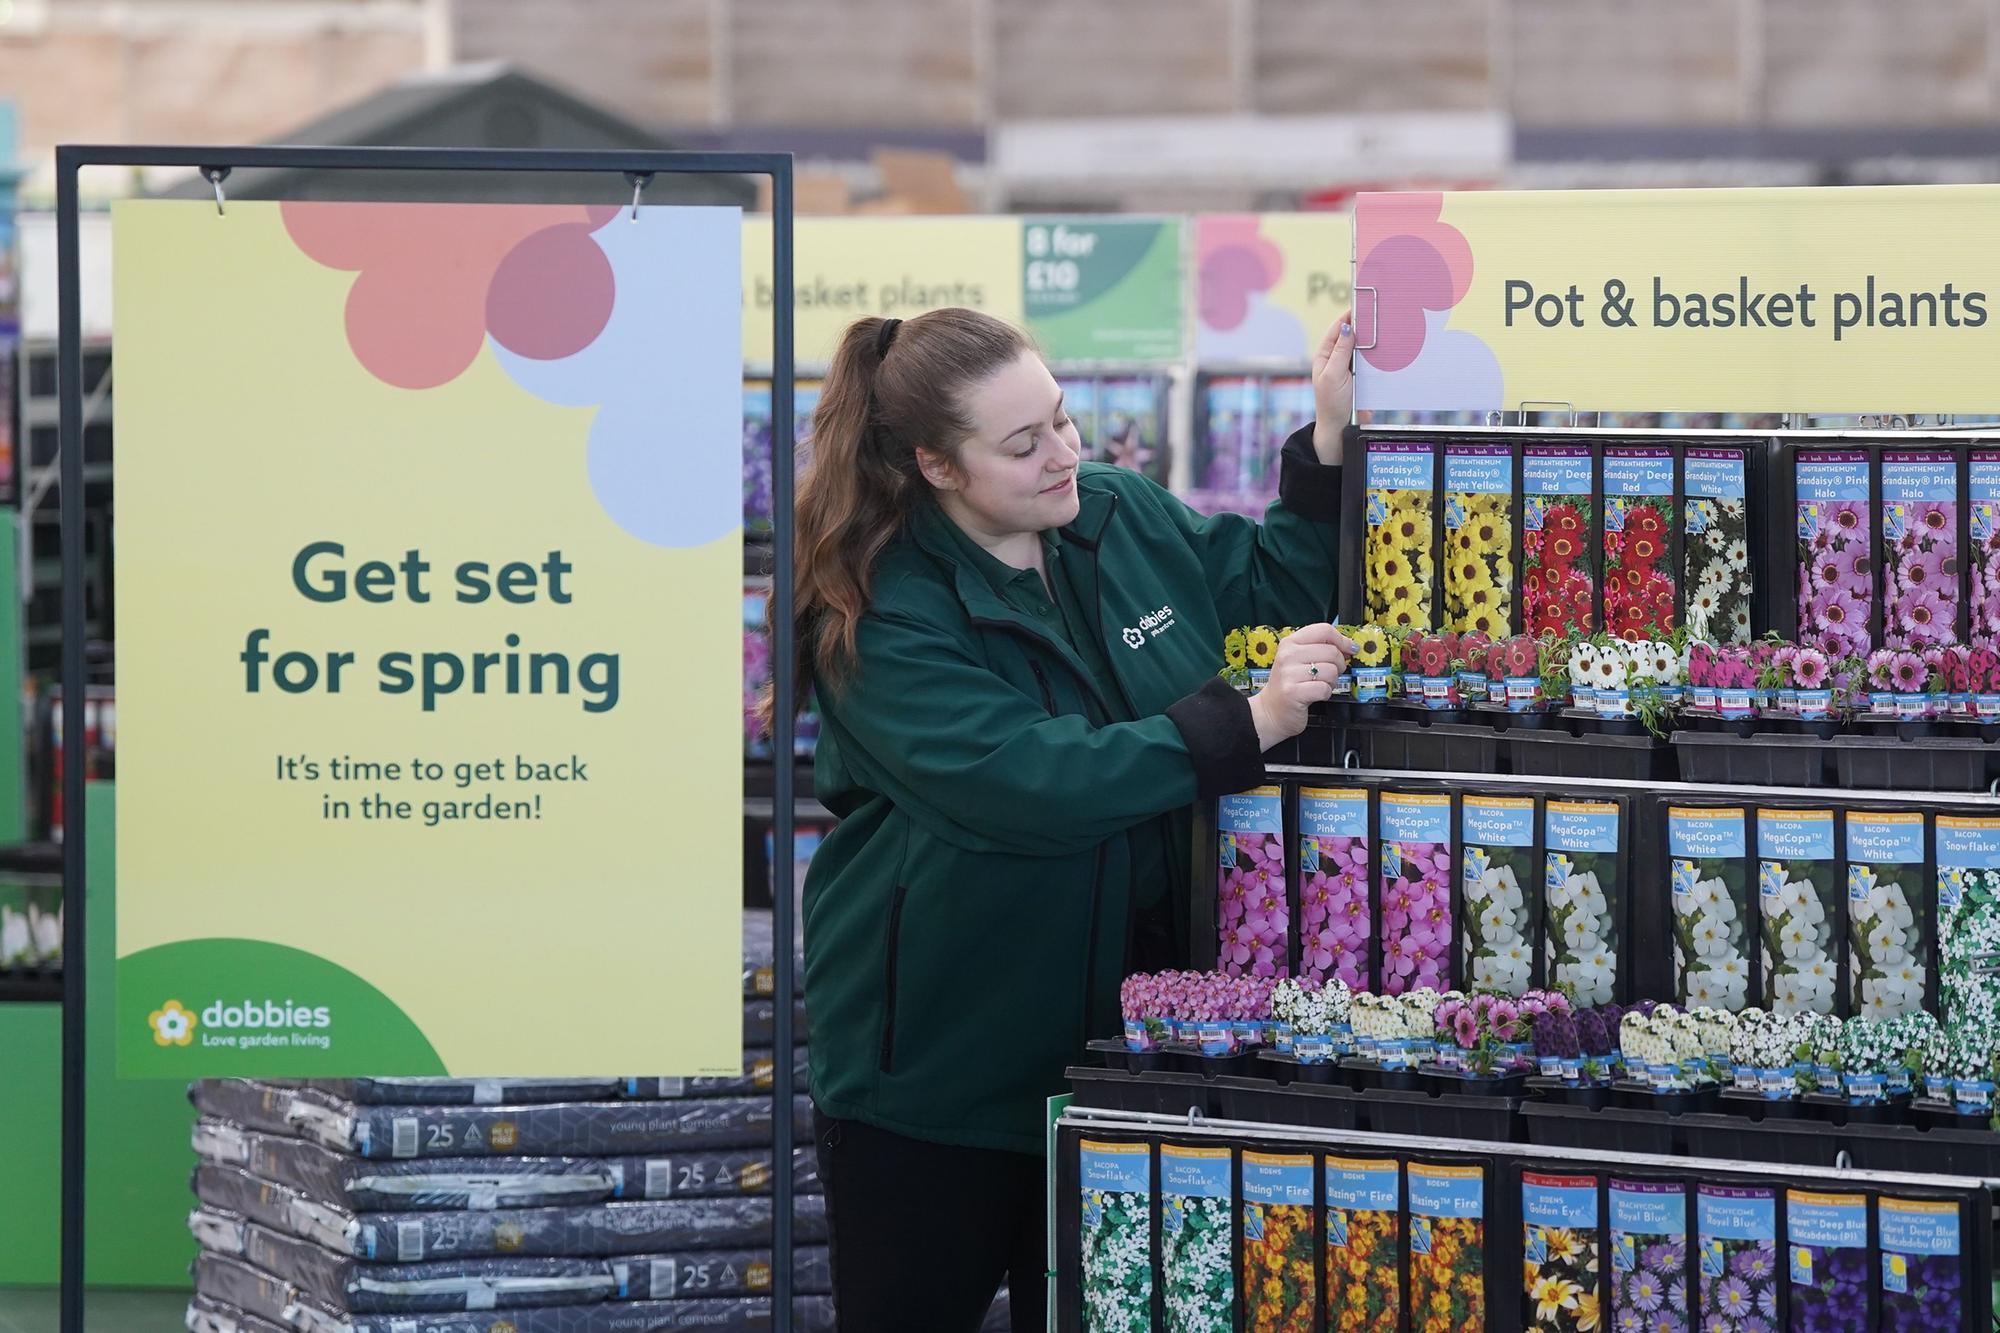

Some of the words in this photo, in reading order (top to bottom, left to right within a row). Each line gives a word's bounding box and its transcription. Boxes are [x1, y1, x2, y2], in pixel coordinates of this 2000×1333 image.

[1027, 228, 1046, 257] 8
[1052, 227, 1096, 257] for
[1027, 262, 1079, 292] £10
[755, 275, 867, 309] bsket
[880, 275, 986, 311] plants
[1504, 278, 1584, 328] Pot
[1601, 278, 1637, 329] &
[1652, 276, 1816, 328] basket
[1833, 274, 1988, 341] plants
[1566, 469, 1592, 480] Deep
[1647, 470, 1673, 480] Deep
[1722, 472, 1744, 484] Ivory
[1370, 477, 1391, 487] Bright
[1393, 477, 1426, 486] Yellow
[1448, 480, 1469, 490] Bright
[1471, 480, 1504, 489] Yellow
[1542, 482, 1560, 491] Red
[1846, 477, 1869, 485] Pink
[1933, 477, 1957, 485] Pink
[1622, 483, 1640, 492] Red
[1700, 484, 1722, 494] White
[1814, 489, 1837, 498] Halo
[1901, 489, 1924, 498] Halo
[292, 541, 430, 604] Get
[454, 549, 572, 605] set
[240, 628, 355, 693] for
[377, 633, 620, 714] spring
[276, 755, 319, 781] It's
[329, 756, 401, 781] time
[411, 760, 444, 781] to
[453, 758, 505, 788] get
[515, 755, 588, 781] back
[322, 795, 350, 819] in
[361, 794, 411, 819] the
[422, 794, 541, 826] garden!
[1233, 820, 1251, 829] Pink
[1316, 824, 1336, 833] Pink
[1399, 829, 1419, 839] Pink
[1477, 832, 1506, 842] White
[1561, 838, 1590, 848] White
[1686, 845, 1717, 854] White
[1774, 846, 1805, 856] White
[1863, 850, 1894, 860] White
[202, 999, 331, 1028] dobbies
[202, 1033, 236, 1047] Love
[239, 1034, 289, 1049] garden
[291, 1033, 330, 1049] living
[609, 1121, 645, 1133] young
[648, 1118, 676, 1132] plant
[680, 1118, 729, 1131] compost
[427, 1124, 453, 1147] 25
[678, 1166, 705, 1190] 25
[1286, 1185, 1310, 1196] Fire
[1369, 1191, 1394, 1202] Fire
[1453, 1199, 1478, 1209] Fire
[1819, 1218, 1844, 1231] Deep
[1846, 1220, 1867, 1230] Blue
[1909, 1224, 1933, 1237] Deep
[1936, 1225, 1958, 1237] Blue
[432, 1226, 458, 1249] 25
[684, 1266, 710, 1288] 25
[609, 1317, 645, 1330] young
[647, 1314, 674, 1329] plant
[677, 1313, 729, 1326] compost
